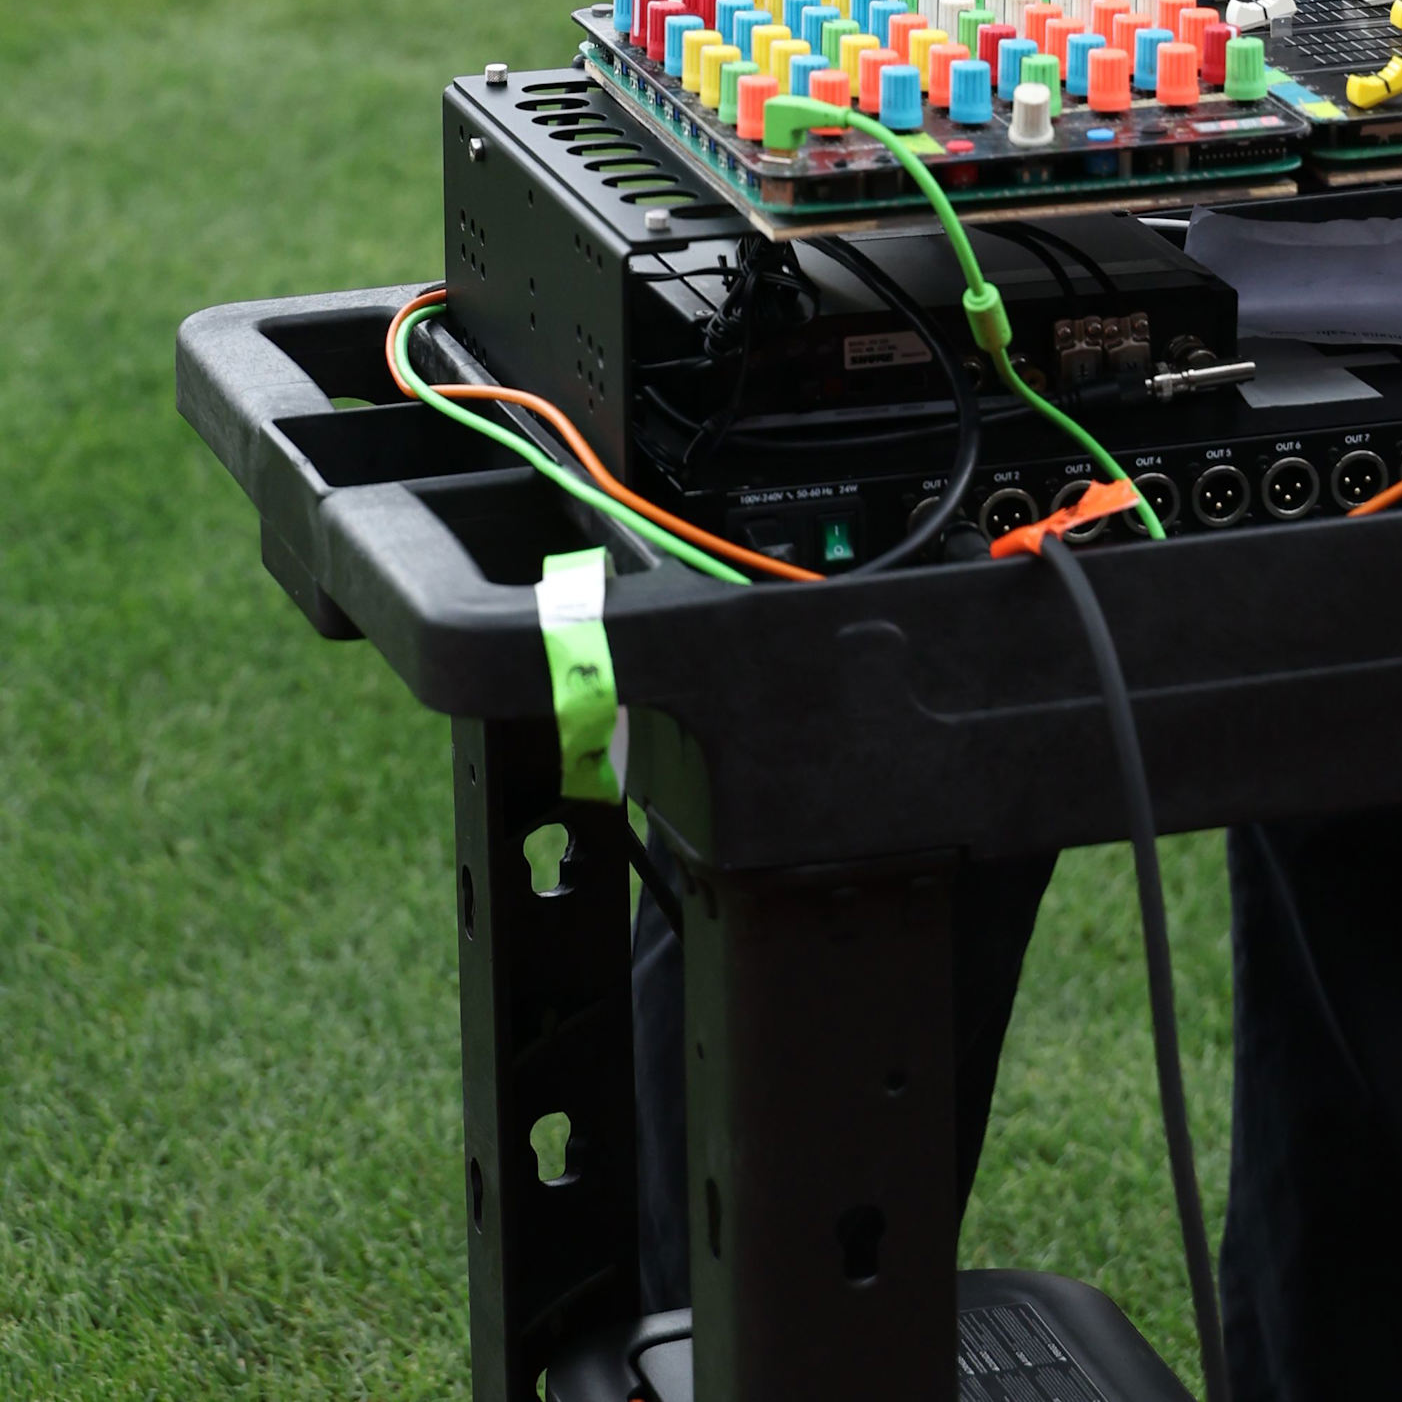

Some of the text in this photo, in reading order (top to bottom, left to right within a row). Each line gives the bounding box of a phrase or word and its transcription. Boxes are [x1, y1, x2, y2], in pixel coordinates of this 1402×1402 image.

[1344, 433, 1370, 444] OUT 7
[1276, 441, 1301, 452] OUT 6
[1206, 448, 1232, 459] OUT 5
[1136, 455, 1162, 467] OUT 4
[1065, 463, 1091, 474] OUT 3
[993, 471, 1020, 483] OUT 2
[922, 480, 941, 491] OUT
